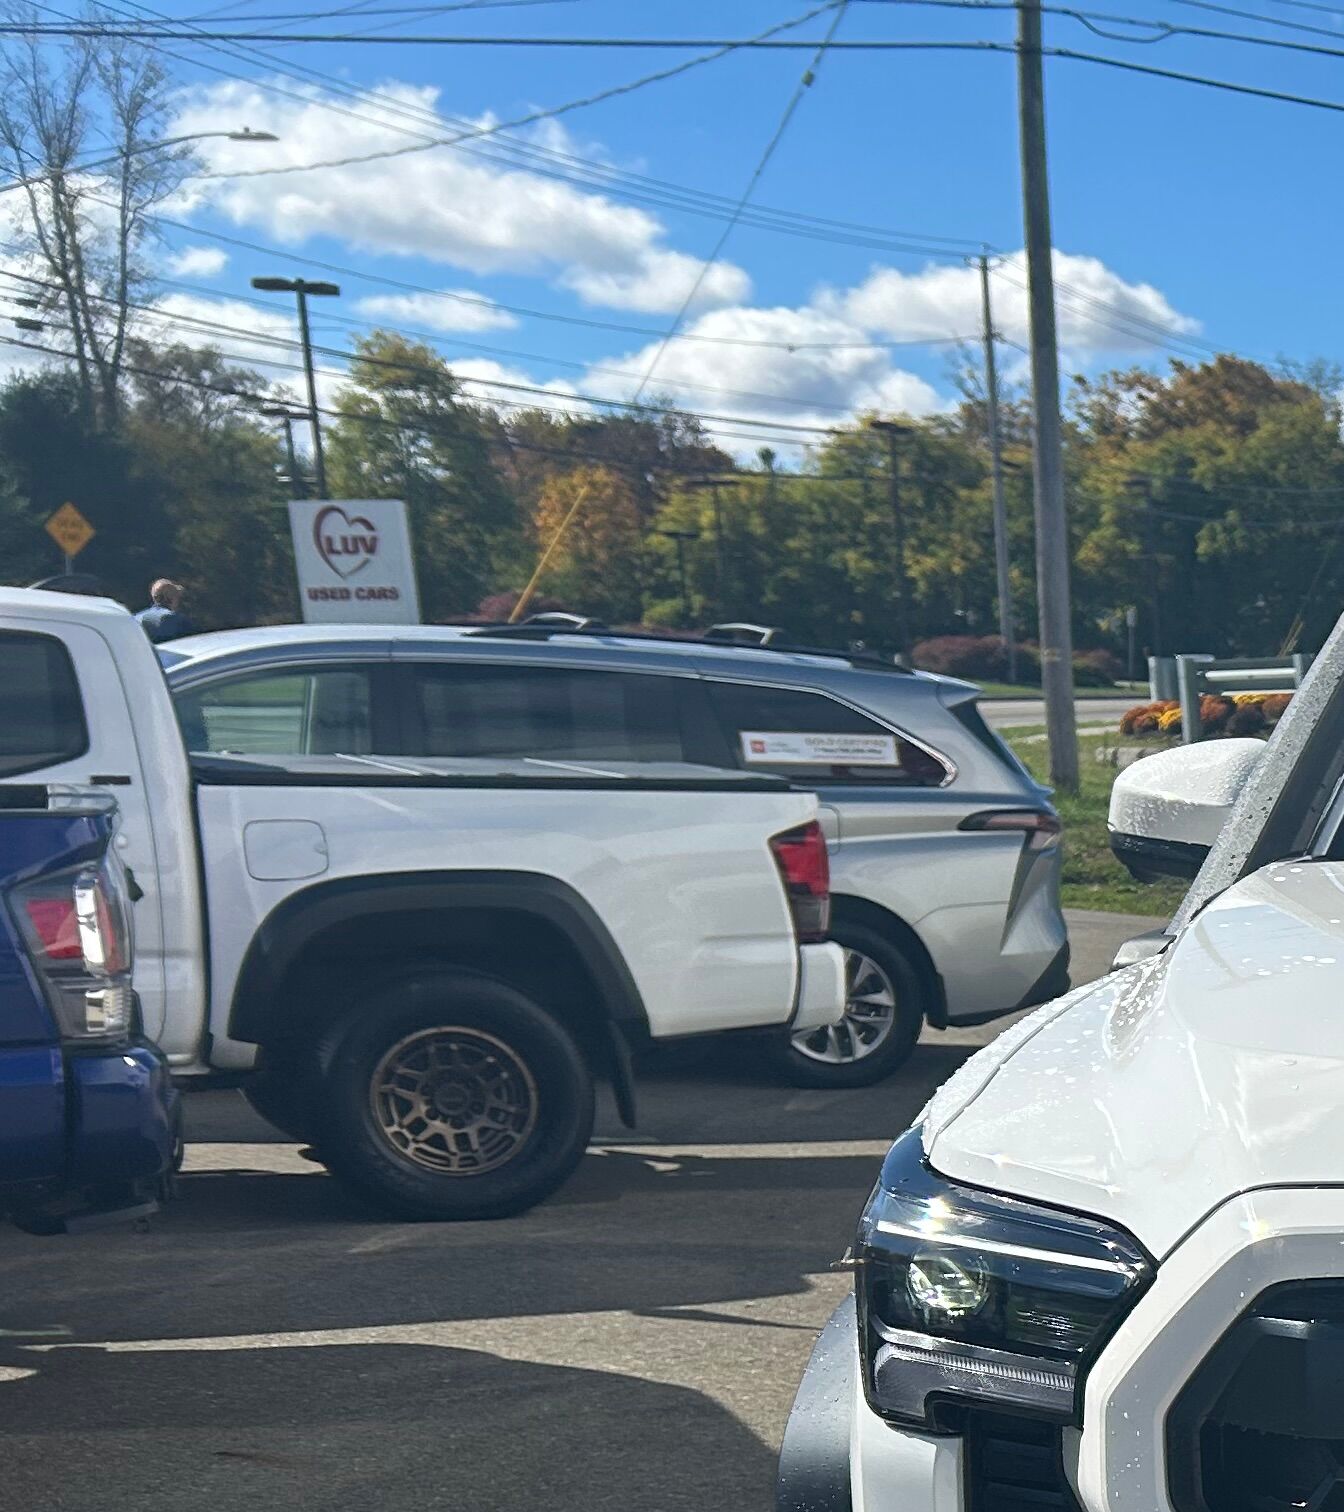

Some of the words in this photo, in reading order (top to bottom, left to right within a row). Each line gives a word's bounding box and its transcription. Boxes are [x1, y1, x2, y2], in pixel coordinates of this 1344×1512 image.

[324, 535, 377, 555] LUV
[306, 587, 351, 601] USED
[354, 587, 399, 601] CARS
